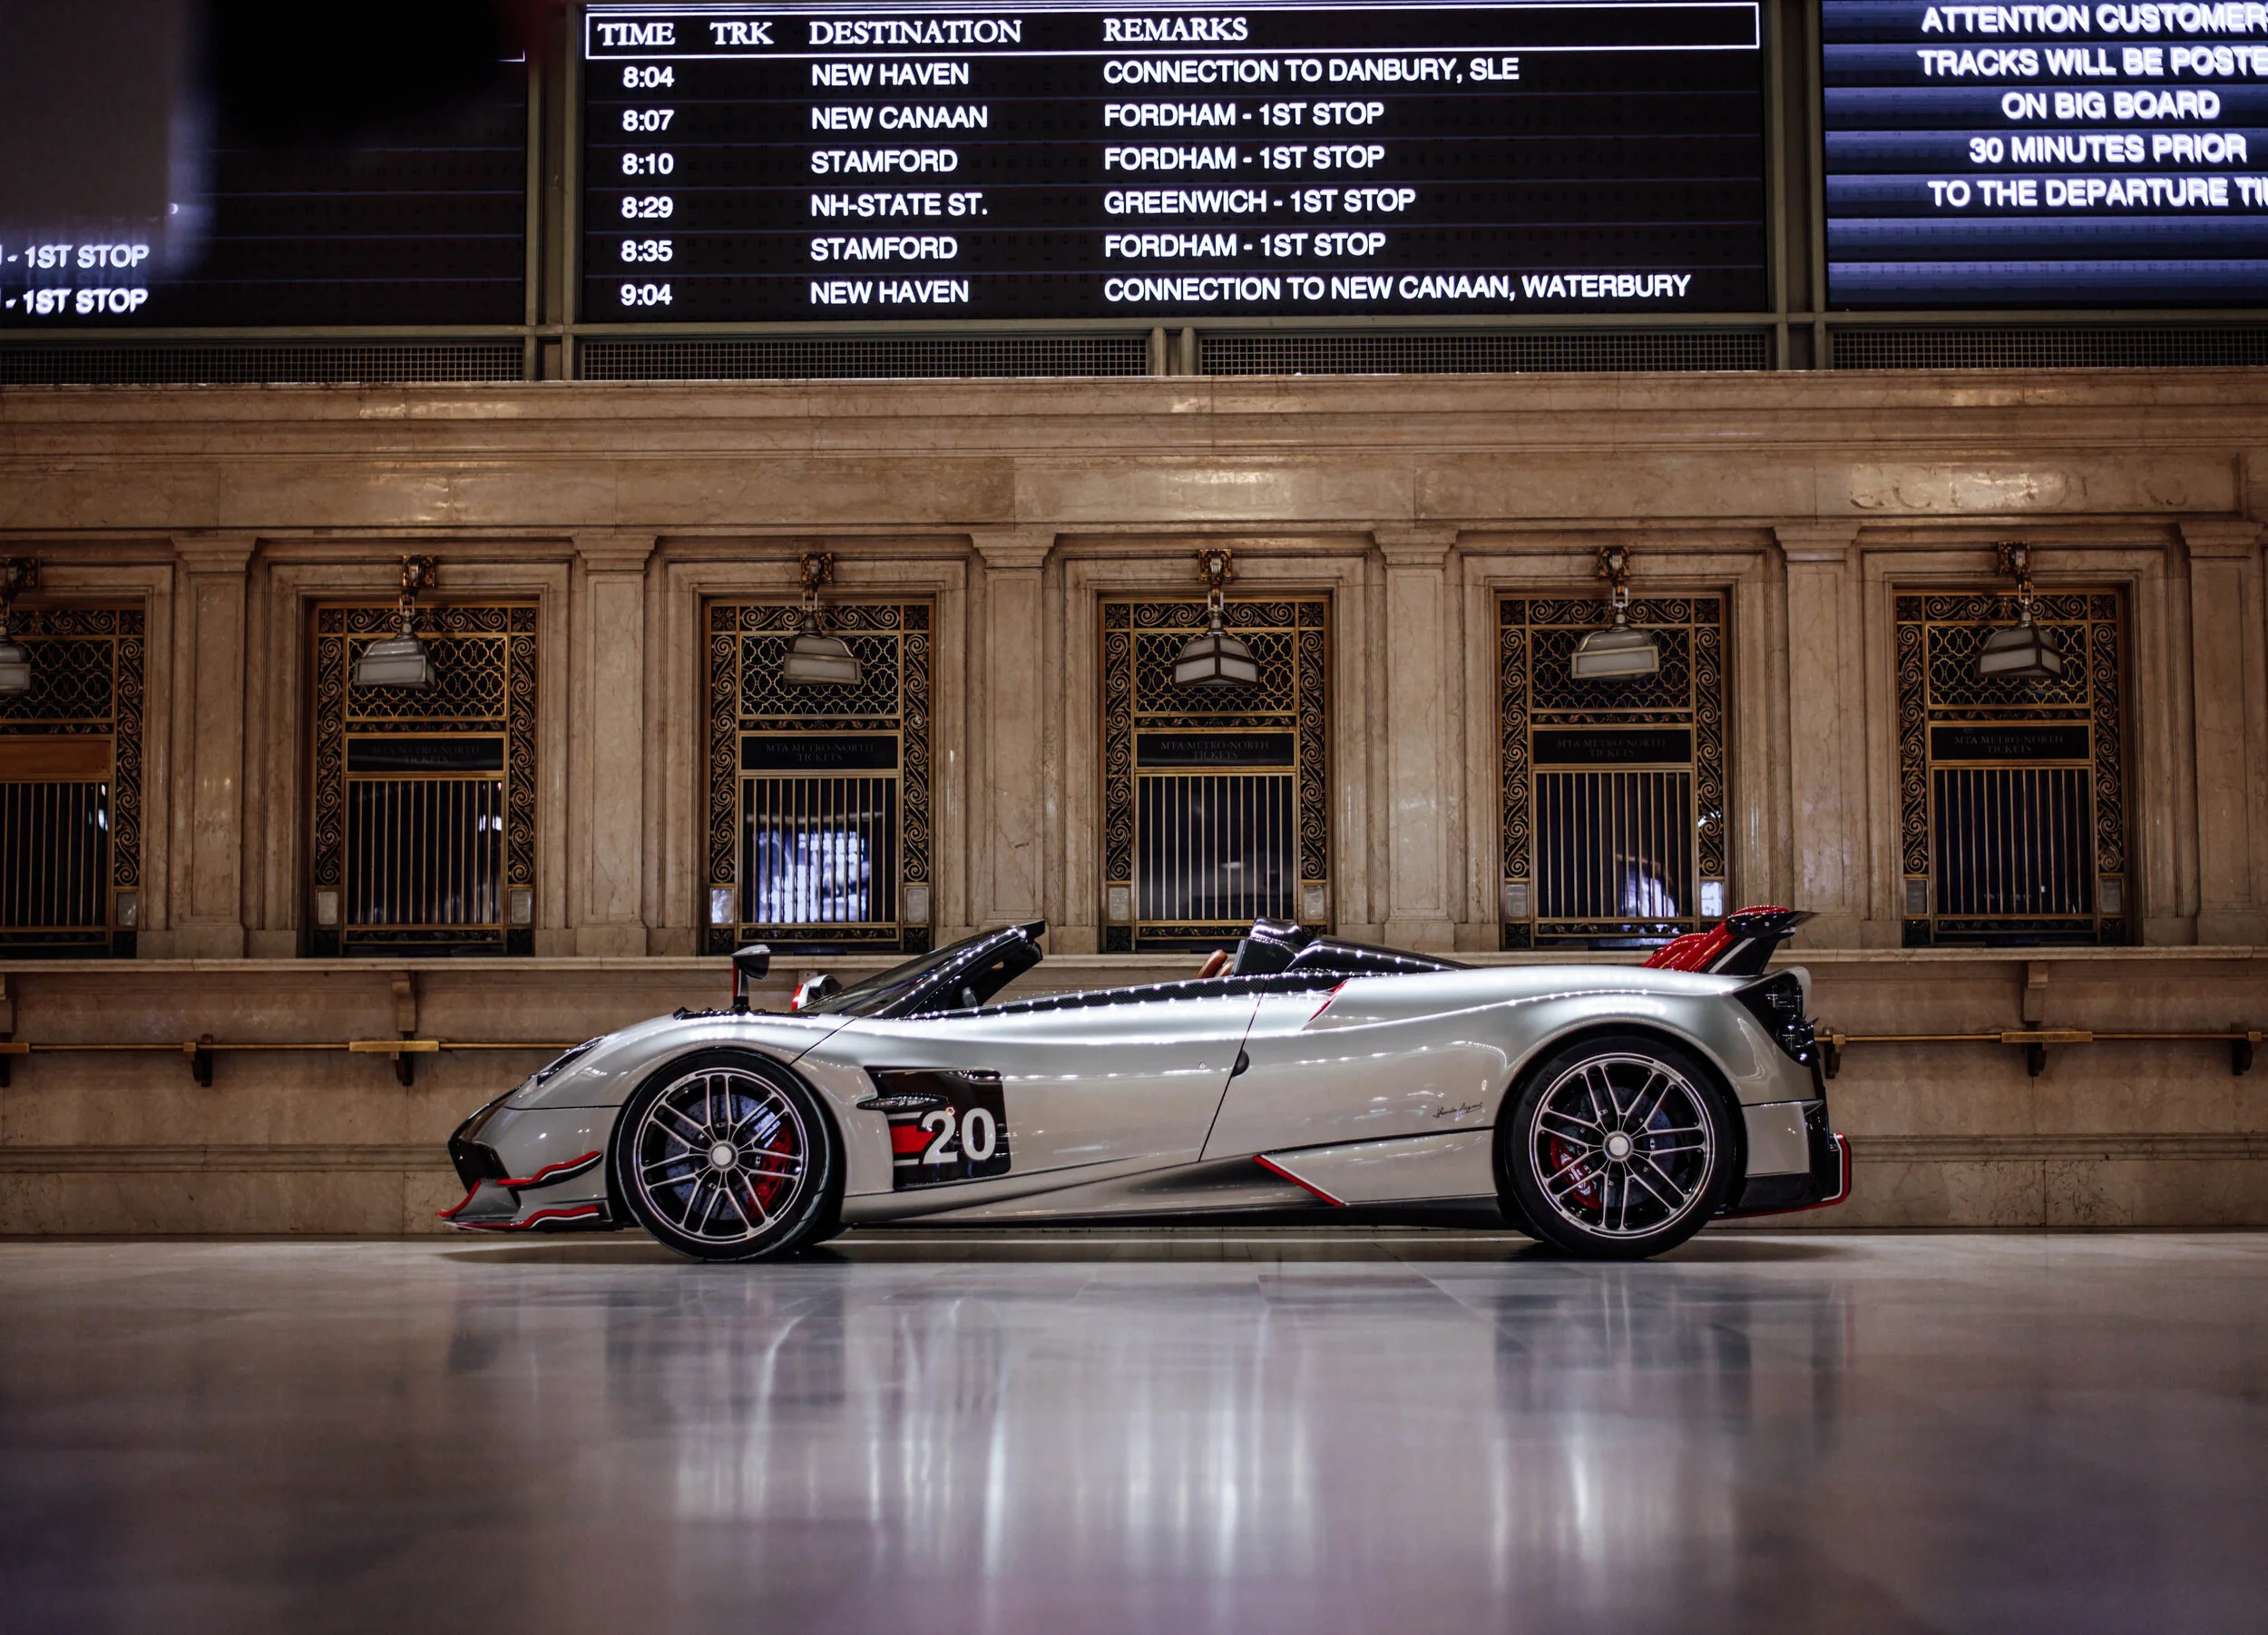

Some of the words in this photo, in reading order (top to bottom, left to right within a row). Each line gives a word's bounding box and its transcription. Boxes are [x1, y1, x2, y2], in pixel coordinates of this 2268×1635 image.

[1102, 16, 1249, 42] REMARKS
[1921, 4, 2090, 33] ATTENTION
[2096, 2, 2268, 33] CUSTOMER
[597, 22, 676, 46] TIME
[709, 21, 775, 45] TRK
[808, 19, 1022, 44] DESTINATION
[811, 63, 874, 86] NEW
[879, 62, 969, 86] HAVEN
[1103, 59, 1279, 84] CONNECTION
[1285, 58, 1323, 83] TO
[1328, 57, 1463, 84] DANBURY,
[1469, 56, 1520, 82] SLE
[1916, 48, 2039, 76] TRACKS
[2044, 47, 2116, 75] WILL
[2122, 46, 2164, 75] BE
[622, 65, 675, 89] 8:04
[811, 106, 874, 130] NEW
[878, 105, 988, 130] CANAAN
[1104, 103, 1237, 128] FORDHAM
[1258, 102, 1307, 127] 1ST
[1312, 101, 1384, 126] STOP
[2001, 92, 2048, 120] ON
[2054, 91, 2107, 119] BIG
[2113, 90, 2221, 119] BOARD
[621, 109, 675, 132] 8:07
[1104, 146, 1237, 171] FORDHAM
[1259, 145, 1308, 170] 1ST
[1313, 144, 1385, 170] STOP
[1969, 137, 2004, 163] 30
[2011, 134, 2146, 163] MINUTES
[2152, 132, 2247, 163] PRIOR
[621, 152, 674, 176] 8:10
[810, 149, 958, 174] STAMFORD
[811, 192, 942, 218] NH-STATE
[947, 191, 988, 217] ST.
[1103, 189, 1267, 215] GREENWICH
[1290, 189, 1339, 213] 1ST
[1343, 188, 1416, 213] STOP
[1927, 180, 1970, 207] TO
[1977, 180, 2038, 207] THE
[2045, 177, 2229, 207] DEPARTURE
[621, 195, 674, 219] 8:29
[6, 254, 18, 262] -
[24, 244, 73, 269] 1ST
[76, 243, 150, 269] STOP
[621, 240, 673, 262] 8:35
[810, 236, 958, 262] STAMFORD
[1104, 232, 1237, 259] FORDHAM
[1260, 232, 1309, 258] 1ST
[1313, 231, 1386, 257] STOP
[620, 283, 673, 307] 9:04
[810, 280, 874, 305] NEW
[878, 279, 969, 304] HAVEN
[1104, 276, 1281, 302] CONNECTION
[1286, 276, 1325, 300] TO
[1331, 276, 1394, 299] NEW
[1398, 275, 1516, 302] CANAAN,
[1520, 274, 1692, 299] WATERBURY
[5, 299, 17, 308] -
[23, 289, 72, 315] 1ST
[75, 288, 149, 314] STOP
[1160, 740, 1184, 749] MTA
[1194, 750, 1237, 759] TICKETS
[922, 1107, 996, 1165] 20
